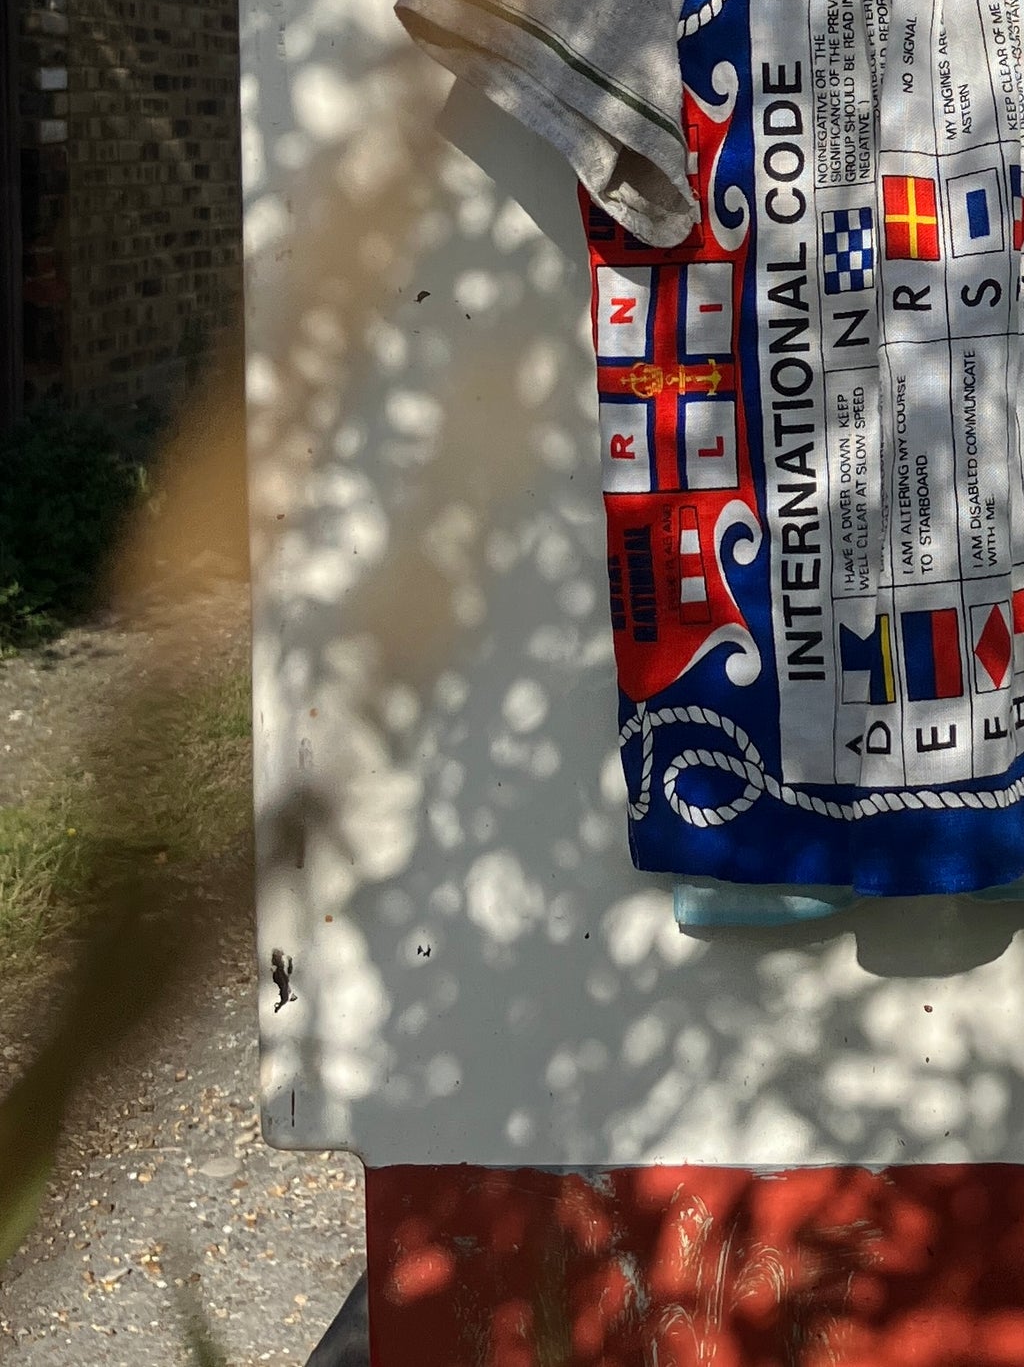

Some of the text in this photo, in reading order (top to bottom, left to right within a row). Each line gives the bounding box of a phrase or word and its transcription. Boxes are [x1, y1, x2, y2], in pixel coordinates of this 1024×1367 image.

[843, 11, 855, 49] READ
[993, 28, 1006, 45] OF
[829, 38, 840, 65] THE
[844, 55, 854, 71] BE
[815, 70, 826, 89] OR
[829, 71, 840, 87] OF
[902, 72, 913, 94] NO
[938, 60, 955, 114] ENGINES
[997, 48, 1013, 93] CLEAR
[844, 77, 856, 133] SHOULD
[957, 84, 972, 134] ASTERN
[1005, 97, 1018, 130] KEEP
[830, 90, 841, 183] SIGNIFICANCE
[946, 120, 957, 140] MY
[844, 136, 857, 182] GROUP
[699, 304, 723, 312] I
[892, 285, 931, 311] R
[961, 278, 1002, 307] S
[610, 298, 636, 324] N
[833, 309, 869, 348] N
[762, 61, 826, 680] INTERNATIONAL CODE
[837, 394, 849, 428] KEEP
[897, 375, 906, 434] COURSE
[963, 350, 977, 455] COMMUNICATE
[610, 434, 635, 459] R
[698, 436, 723, 457] L
[898, 438, 909, 461] MY
[853, 387, 869, 591] WELL CLEAR AT SLOW SPEED
[898, 464, 912, 534] ALTERING
[967, 458, 982, 529] DISABLED
[840, 490, 852, 529] DIVER
[842, 533, 852, 543] A
[901, 541, 914, 566] AM
[972, 535, 983, 560] AM
[987, 526, 997, 566] WITH
[843, 548, 855, 583] HAVE
[920, 554, 933, 575] TO
[866, 720, 891, 754] D
[916, 724, 956, 752] E
